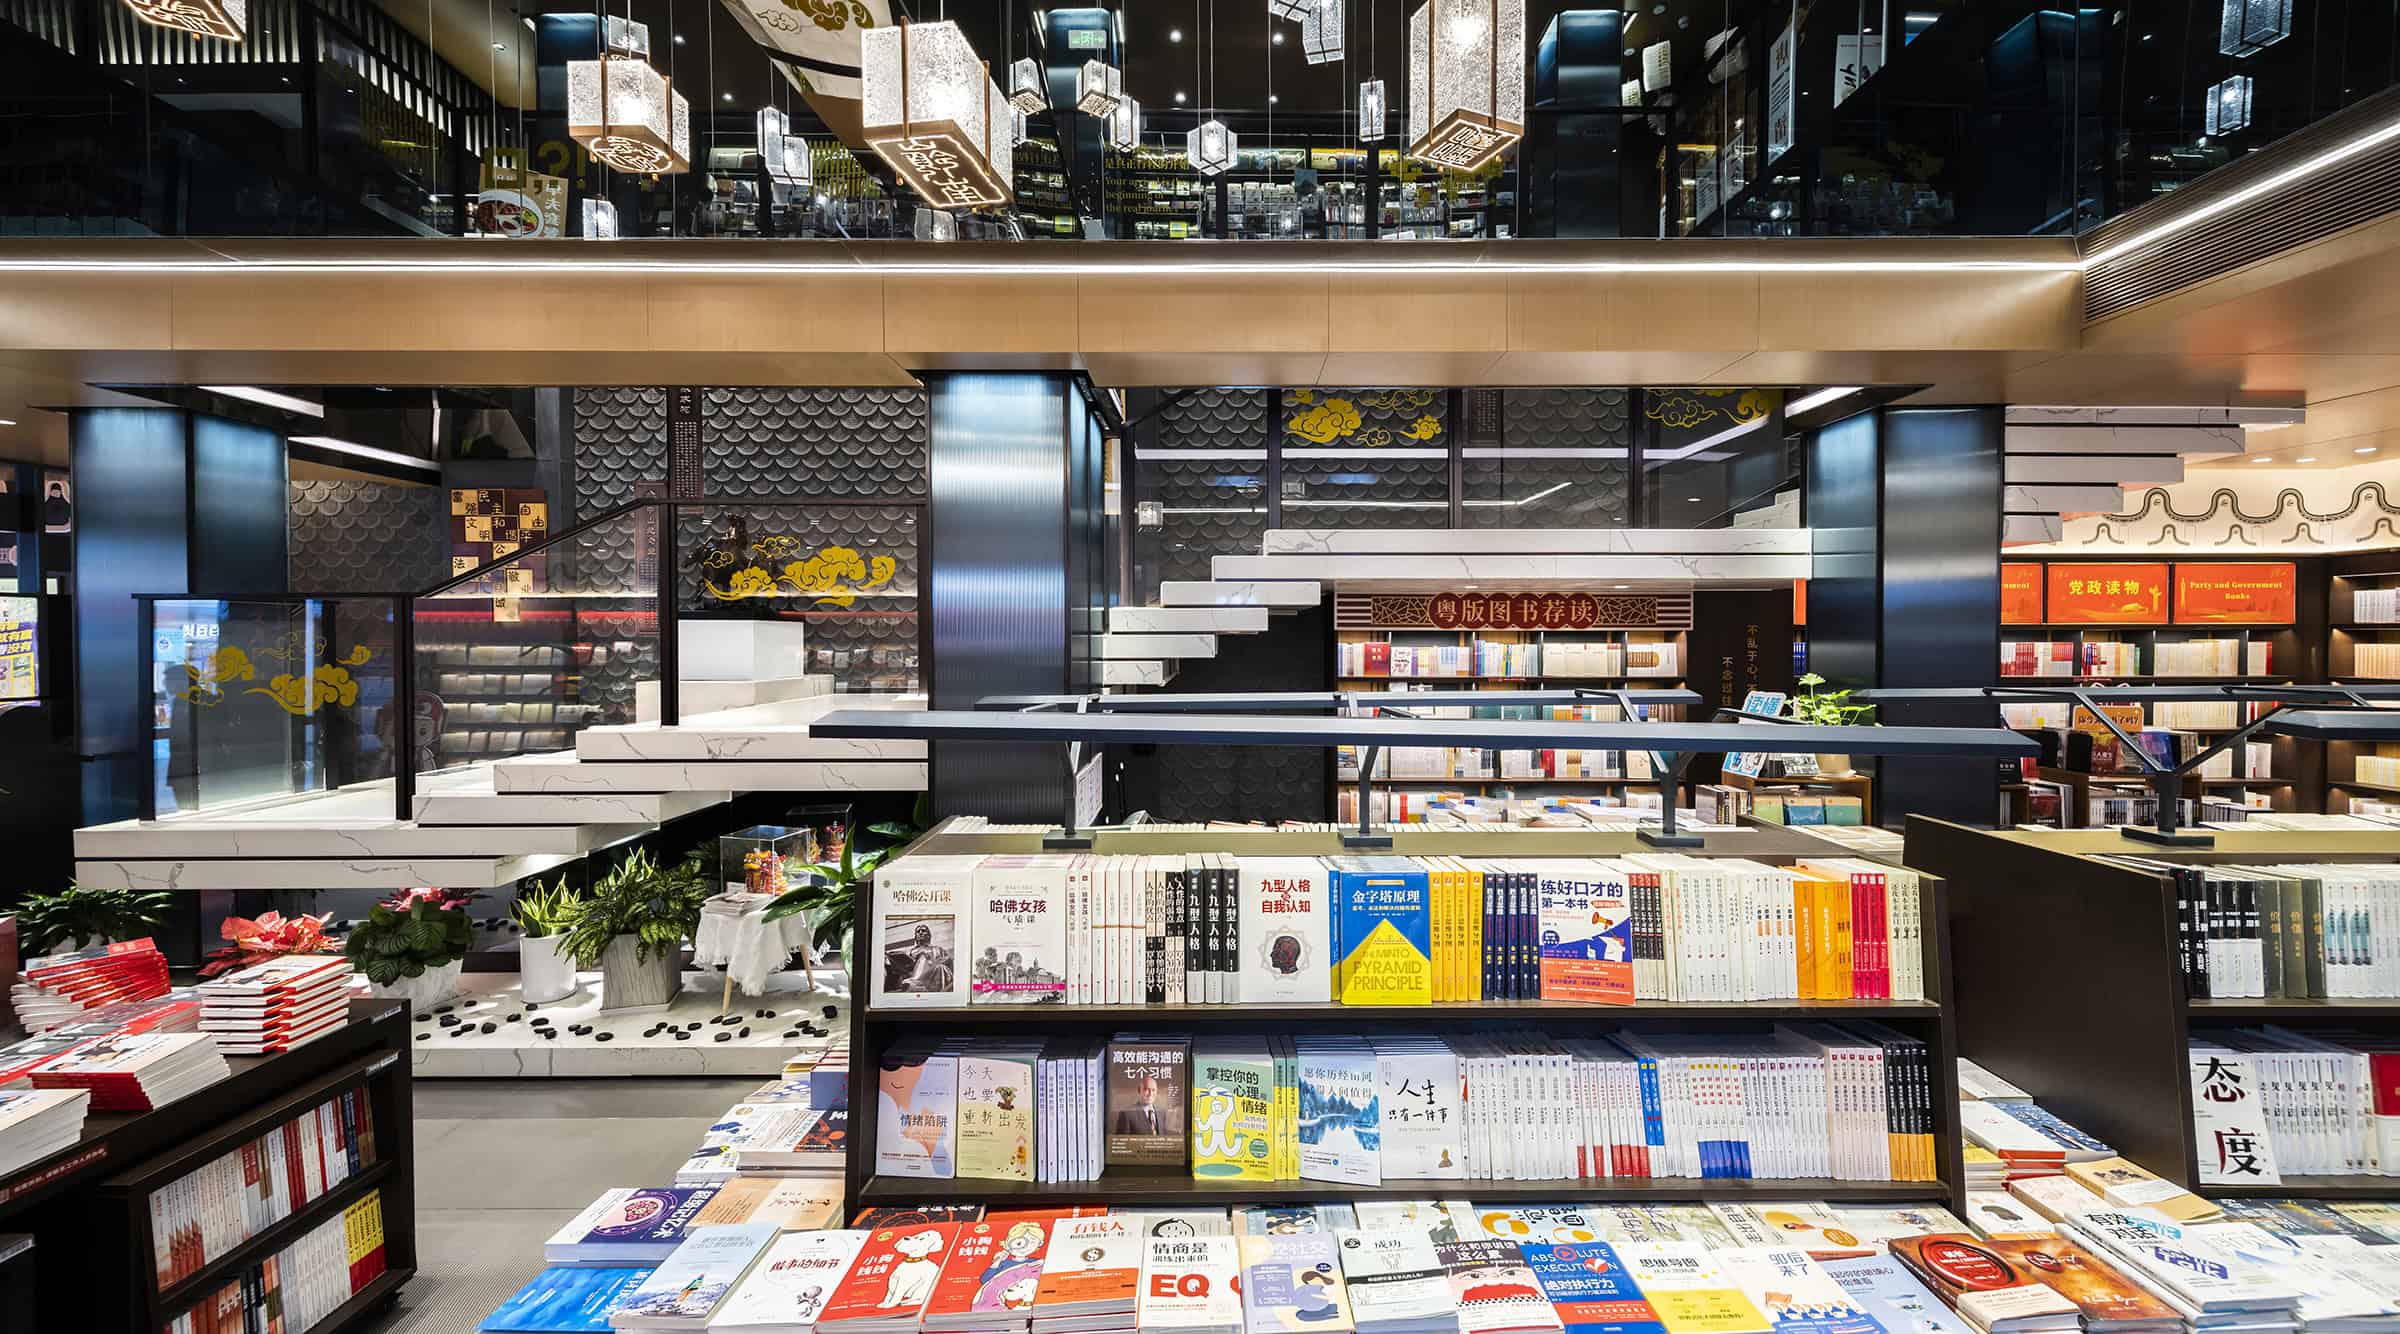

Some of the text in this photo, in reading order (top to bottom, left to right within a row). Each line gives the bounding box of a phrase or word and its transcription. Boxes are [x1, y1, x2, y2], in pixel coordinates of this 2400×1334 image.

[520, 505, 544, 527] 自由
[2069, 580, 2140, 595] 党政读物
[2190, 582, 2213, 591] Party
[1437, 599, 1593, 624] 粤版图书荐读
[1261, 879, 1311, 893] 九型人格
[1541, 880, 1623, 897] 练好口才的
[892, 890, 951, 903] 哈佛公开课
[1352, 890, 1420, 904] 金字塔原理
[990, 900, 1046, 913] 哈佛女孩
[1261, 901, 1311, 913] 自我认知
[1541, 898, 1588, 910] 第一本书
[1189, 893, 1200, 950] 九型人格
[1208, 893, 1219, 950] 九型人格
[1226, 893, 1237, 950] 九型人格
[1354, 961, 1422, 974] PYRAMID
[1354, 976, 1423, 990] PRINCIPLE
[1113, 1051, 1183, 1064] 高效能沟通的
[963, 1065, 993, 1081] 今天
[1124, 1066, 1172, 1079] 七个习惯
[1206, 1067, 1259, 1084] 掌控你的
[1303, 1066, 1372, 1082] 愿你历经山河
[963, 1087, 995, 1102] 也要
[1397, 1079, 1436, 1104] 人生
[1242, 1101, 1267, 1115] 情绪
[900, 1113, 947, 1128] 情绪陷阱
[1388, 1108, 1449, 1123] 只有一件事
[2195, 1056, 2262, 1176] 态度
[1073, 1221, 1125, 1234] 有钱人
[962, 1236, 993, 1246] 小狗
[958, 1246, 989, 1256] 钱钱
[1152, 1242, 1208, 1255] 情商是
[1455, 1250, 1503, 1261] 这么累
[1531, 1246, 1609, 1263] ABSOLUTE
[863, 1254, 895, 1265] 小狗
[1534, 1259, 1619, 1274] EXECUTION
[856, 1264, 889, 1276] 钱钱
[1778, 1264, 1809, 1277] 来了
[1150, 1274, 1211, 1298] EQ
[1545, 1280, 1616, 1291] 绝对执行力
